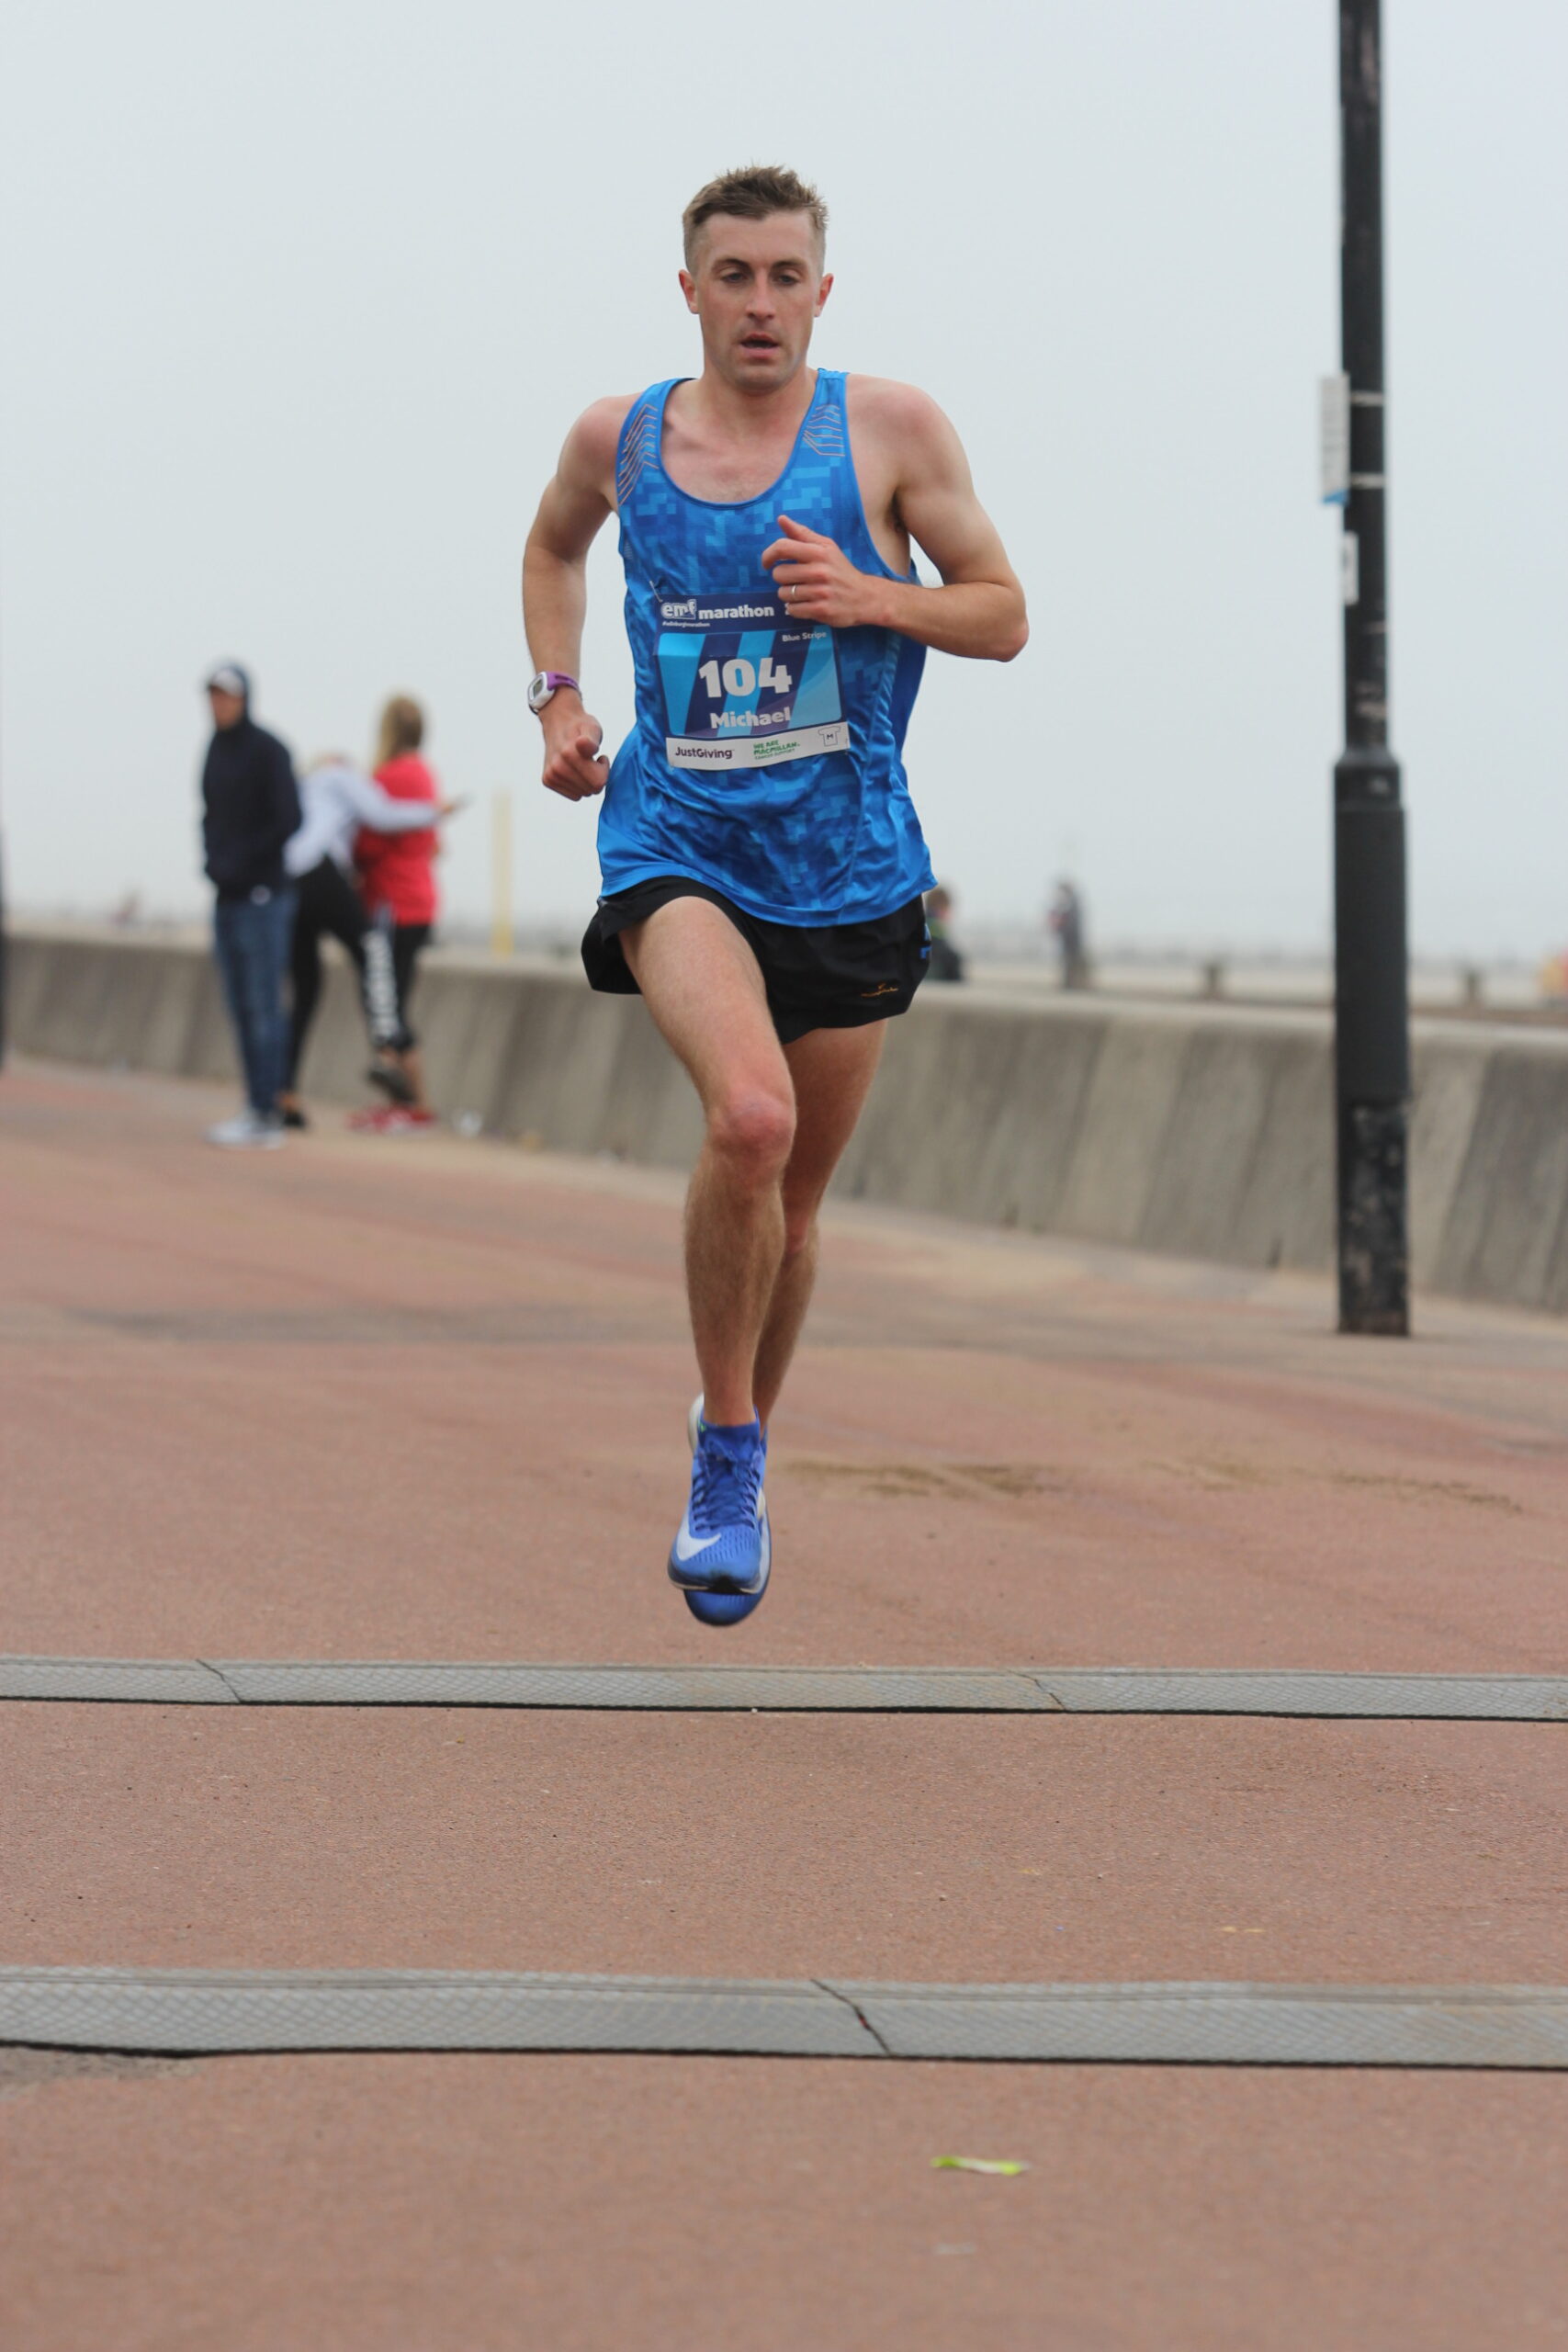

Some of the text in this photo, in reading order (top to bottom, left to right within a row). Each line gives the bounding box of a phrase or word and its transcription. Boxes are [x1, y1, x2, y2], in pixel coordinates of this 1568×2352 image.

[698, 604, 775, 620] marathon
[782, 631, 827, 642] Blue Stripe
[698, 657, 793, 698] 104
[709, 707, 792, 729] Michael
[674, 746, 734, 760] JustGiving
